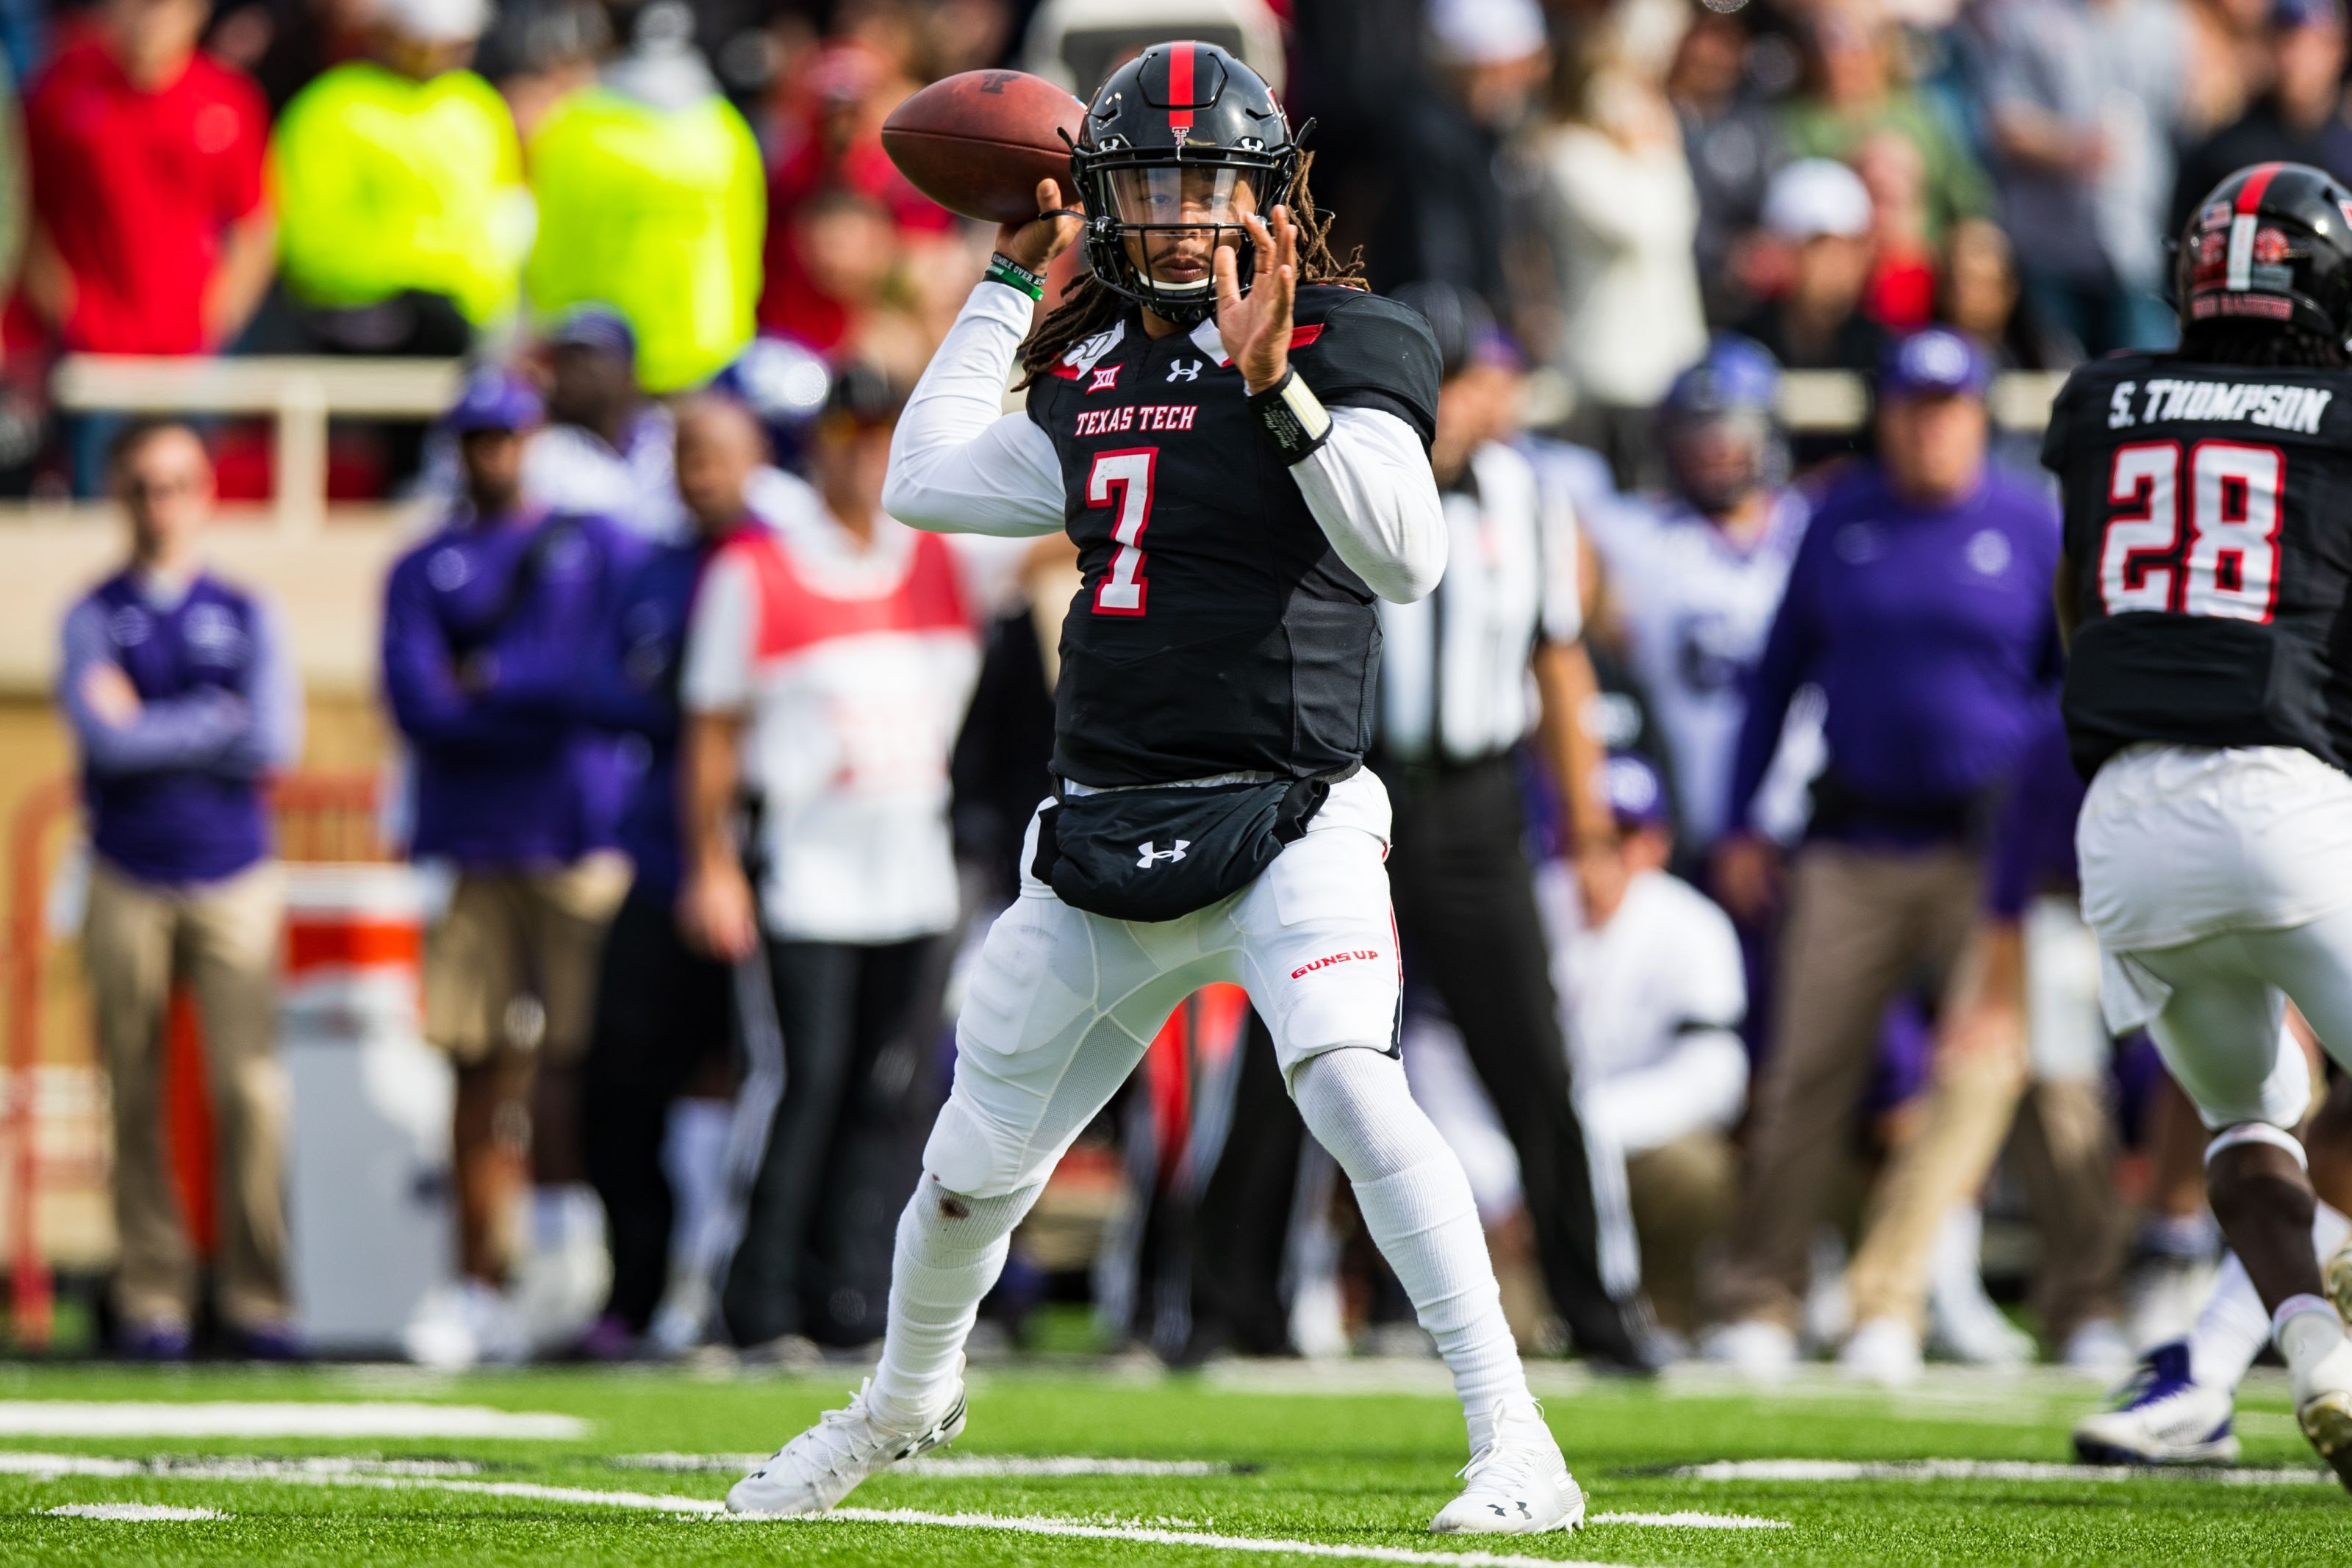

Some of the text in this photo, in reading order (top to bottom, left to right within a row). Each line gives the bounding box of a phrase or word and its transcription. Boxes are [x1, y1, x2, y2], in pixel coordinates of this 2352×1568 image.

[1014, 266, 1033, 281] OVER
[1074, 405, 1199, 437] TEXAS TECH
[2107, 378, 2334, 435] S. THOMPSON
[1085, 447, 1160, 616] 7
[2098, 439, 2287, 625] 28
[1291, 950, 1380, 979] GUNS UP
